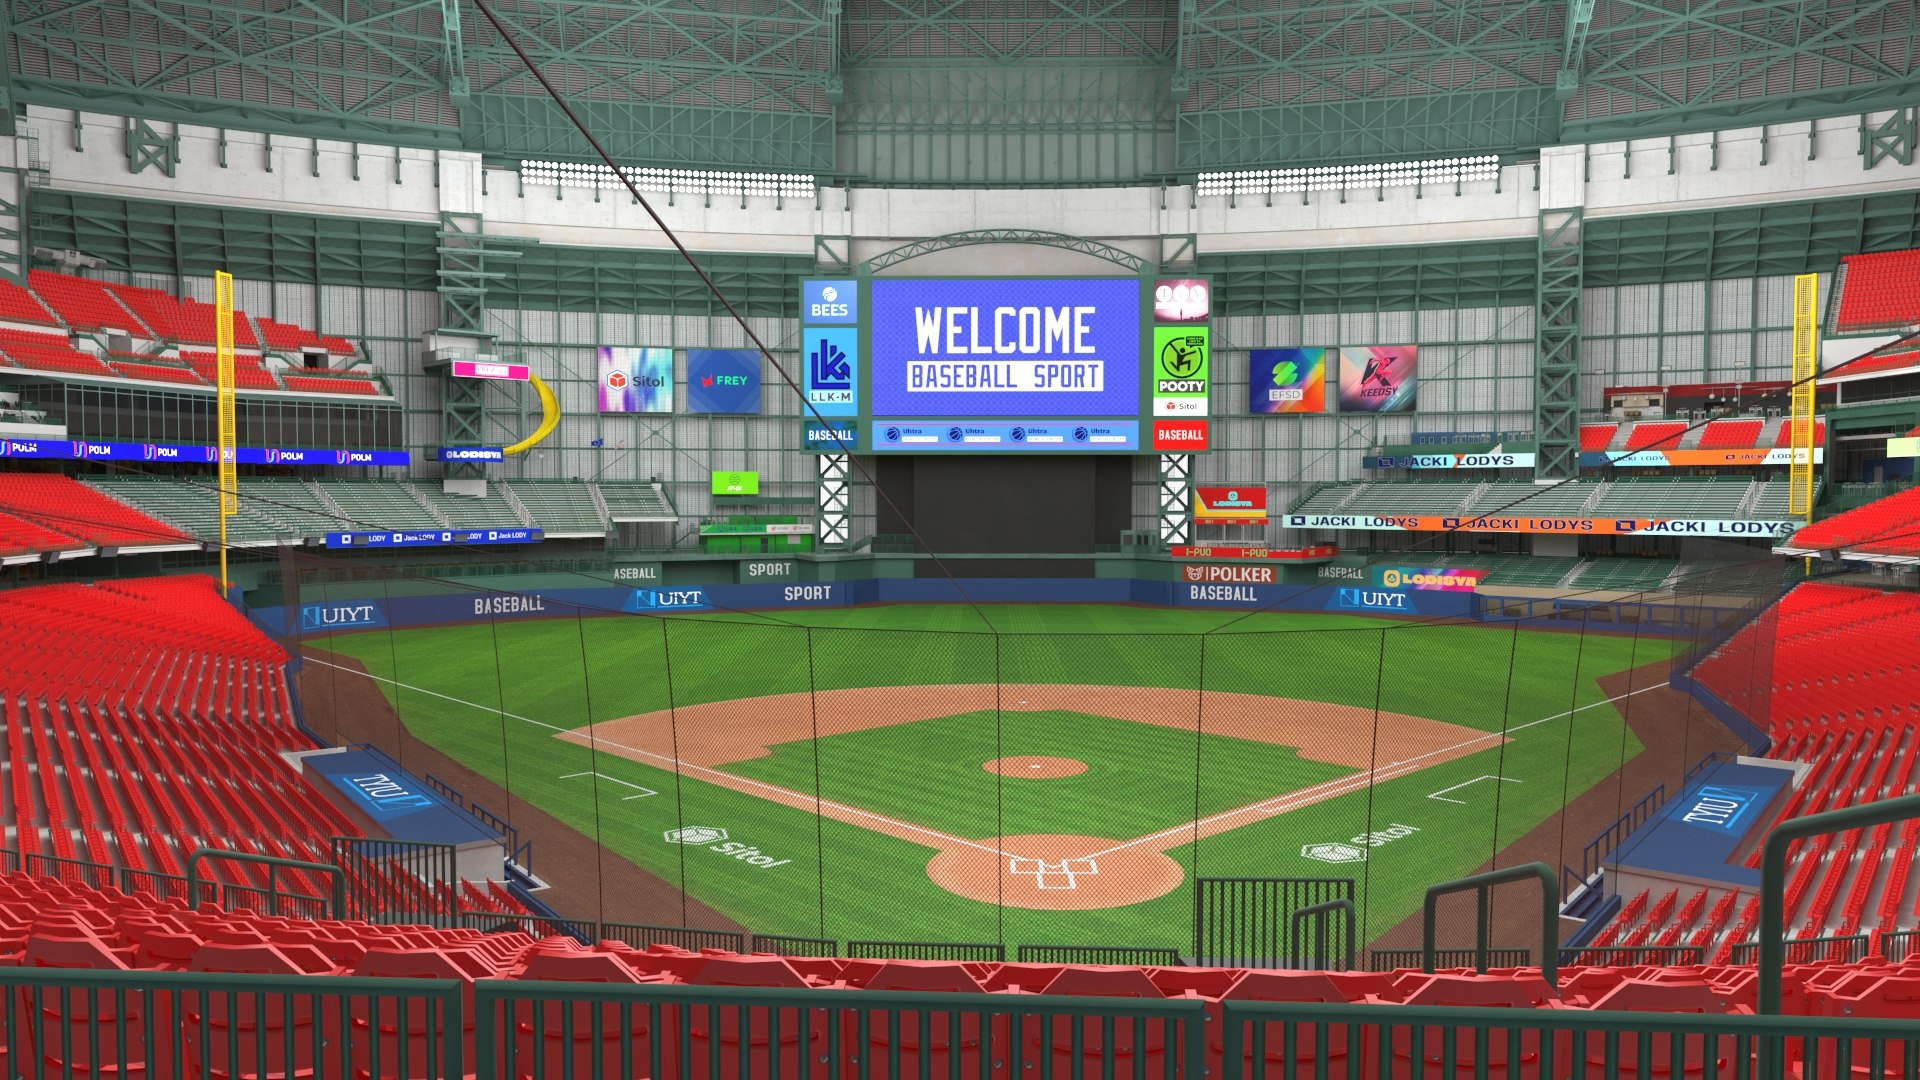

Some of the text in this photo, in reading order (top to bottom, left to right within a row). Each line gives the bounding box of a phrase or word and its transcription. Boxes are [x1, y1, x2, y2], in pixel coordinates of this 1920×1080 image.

[812, 304, 848, 316] BEES
[914, 306, 1096, 354] WELCOME
[632, 375, 664, 387] Sitol
[717, 376, 747, 386] FREY
[912, 364, 1099, 388] BASEBALL SPORT
[1159, 381, 1204, 392] POOTY
[1360, 387, 1398, 397] KEEDSY
[811, 392, 851, 401] LLK-M
[1272, 391, 1301, 399] EFSD
[1158, 429, 1204, 441] BASEBALL
[89, 445, 110, 455] POLM
[157, 447, 178, 457] POLM
[281, 452, 303, 460] POLM
[351, 453, 372, 462] POLM
[1399, 455, 1514, 467] JACKI LODYS
[1311, 516, 1418, 527] JACKI LODYS
[1467, 519, 1593, 530] JACKI LODYS
[1644, 521, 1794, 534] JACKI LODYS
[614, 568, 657, 579] ASEBALL
[749, 563, 791, 576] SPORT
[1210, 566, 1271, 582] POLKER
[1318, 566, 1364, 579] BASEBALL
[658, 591, 702, 606] UIYT
[784, 586, 832, 601] SPORT
[1190, 585, 1257, 601] BASEBALL
[474, 595, 545, 615] BASEBALL
[1362, 592, 1405, 607] UIYT
[322, 605, 374, 623] UIYT
